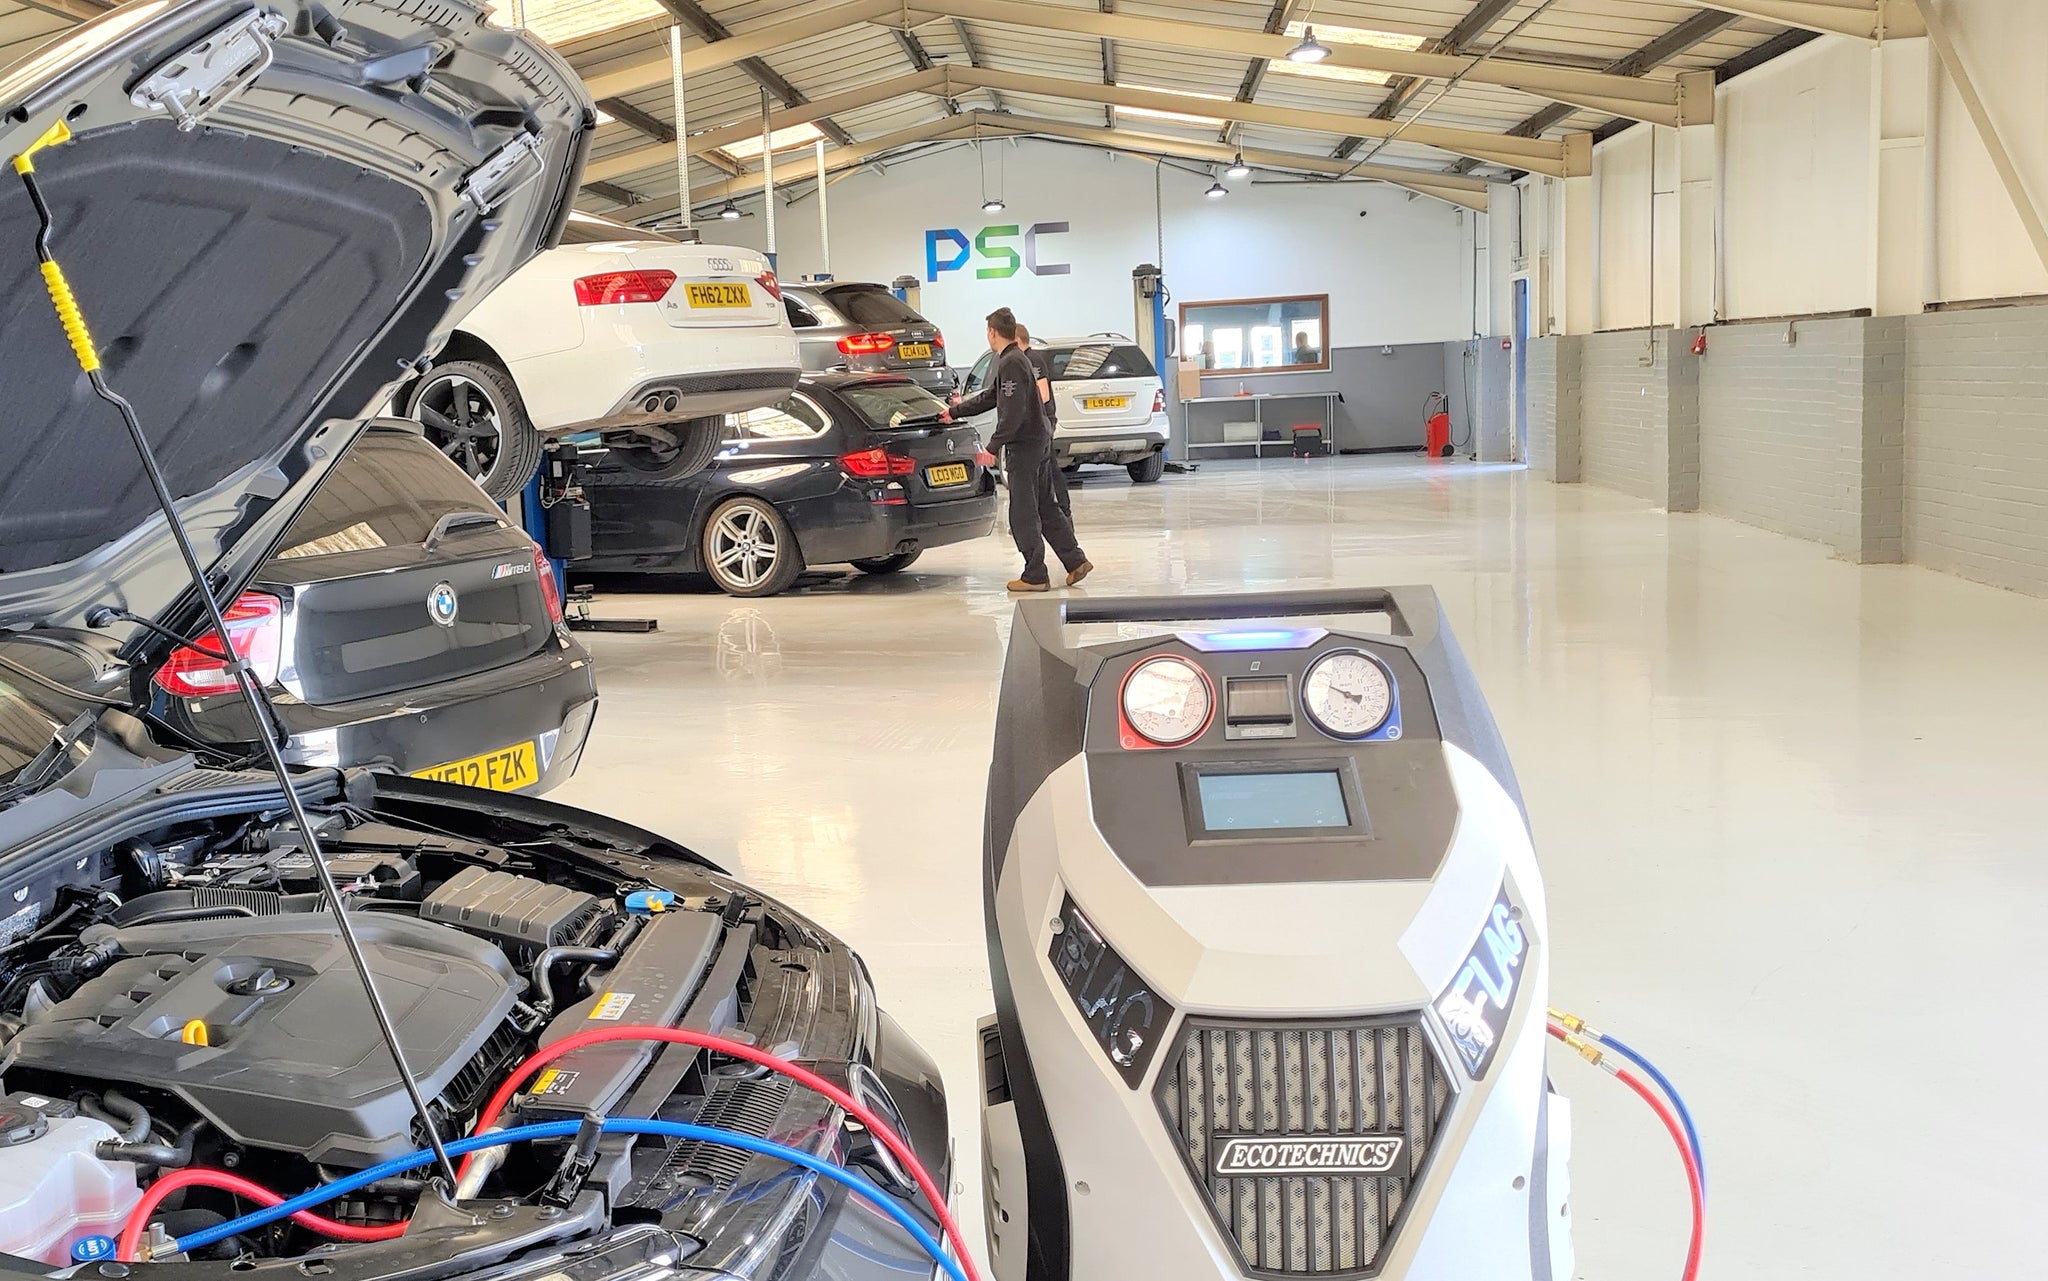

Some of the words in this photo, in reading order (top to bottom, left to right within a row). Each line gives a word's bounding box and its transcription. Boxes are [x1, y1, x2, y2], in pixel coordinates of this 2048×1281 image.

[925, 221, 1071, 282] PSC
[691, 286, 722, 304] FH62
[723, 286, 747, 303] ZXX
[1093, 399, 1104, 407] L9
[931, 468, 950, 483] LC13
[486, 749, 527, 788] FZK
[1438, 903, 1523, 1046] FLAG
[1229, 1141, 1390, 1168] ECOTECHNICS
[86, 1240, 99, 1256] LOW
